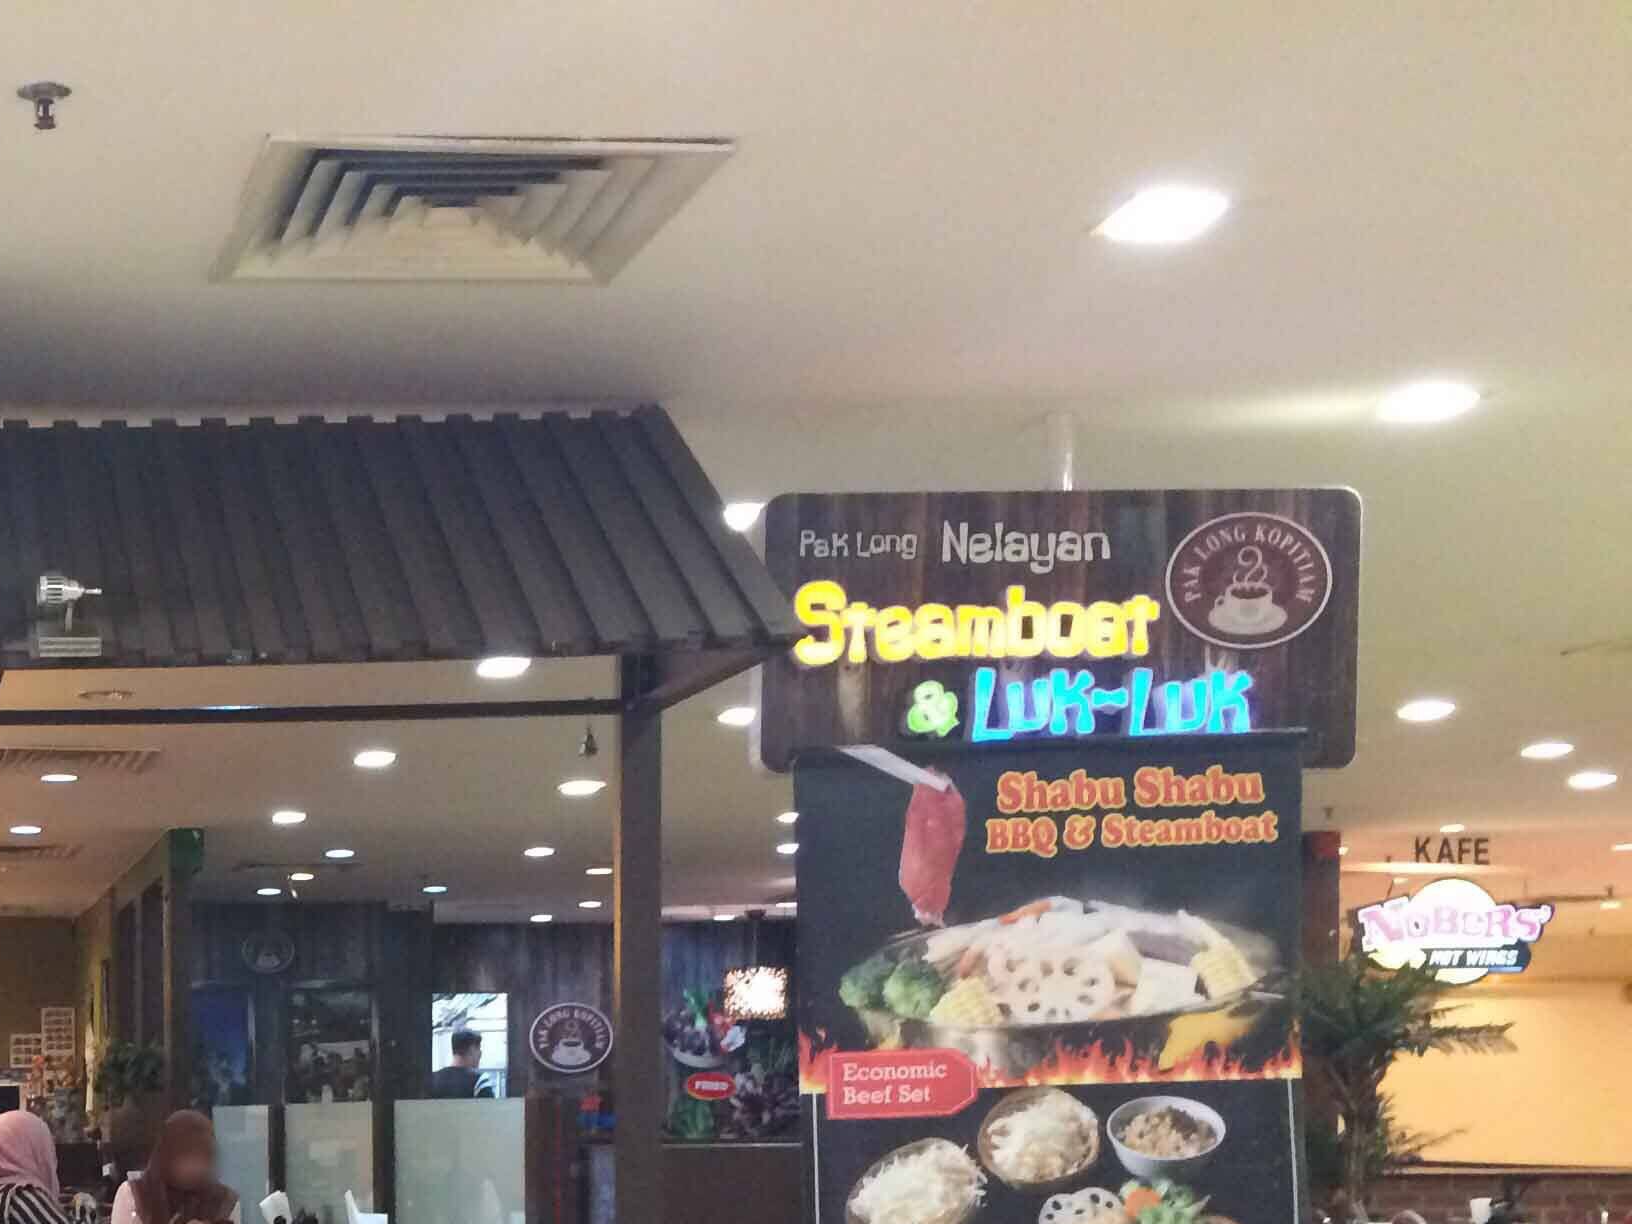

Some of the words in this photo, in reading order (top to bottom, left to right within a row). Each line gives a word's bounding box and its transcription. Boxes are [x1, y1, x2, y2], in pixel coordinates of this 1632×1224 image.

[856, 531, 918, 560] Long
[941, 519, 1112, 575] Nelayan
[1193, 525, 1247, 561] LONG
[794, 579, 1160, 667] Steamboat
[996, 768, 1127, 814] Shabu
[1133, 764, 1266, 807] Shabu
[985, 816, 1058, 858] BBQ
[1063, 813, 1096, 850] &
[1101, 809, 1279, 848] Steamboat
[1415, 837, 1490, 864] KAFE
[842, 1060, 947, 1082] Economic
[842, 1085, 893, 1105] Beef
[898, 1084, 932, 1104] Set
